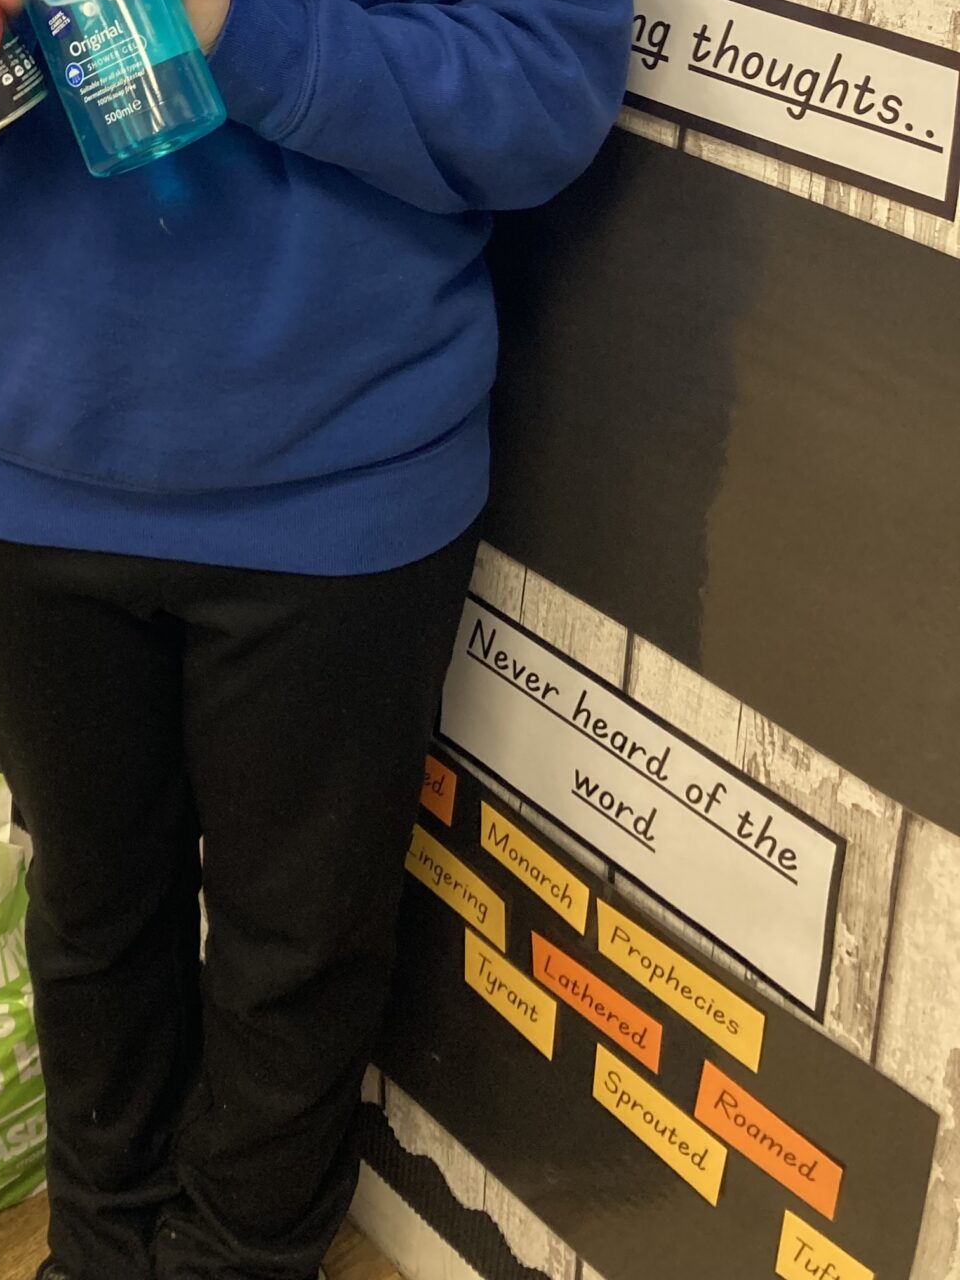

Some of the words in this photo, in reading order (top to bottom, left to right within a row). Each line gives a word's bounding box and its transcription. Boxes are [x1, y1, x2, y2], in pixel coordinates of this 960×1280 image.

[69, 19, 124, 57] Original
[633, 14, 670, 70] ng
[468, 619, 559, 701] Never
[572, 691, 669, 781] heard
[685, 782, 727, 814] of
[737, 810, 798, 871] the
[574, 769, 656, 843] word
[487, 822, 573, 909] Monarch
[477, 952, 539, 1023] Tyrant
[543, 956, 648, 1050] Lathered
[610, 925, 740, 1036] Prophecies
[603, 1070, 708, 1171] Sprouted
[713, 1089, 816, 1183] Roamed
[794, 1236, 840, 1280] Tuf
